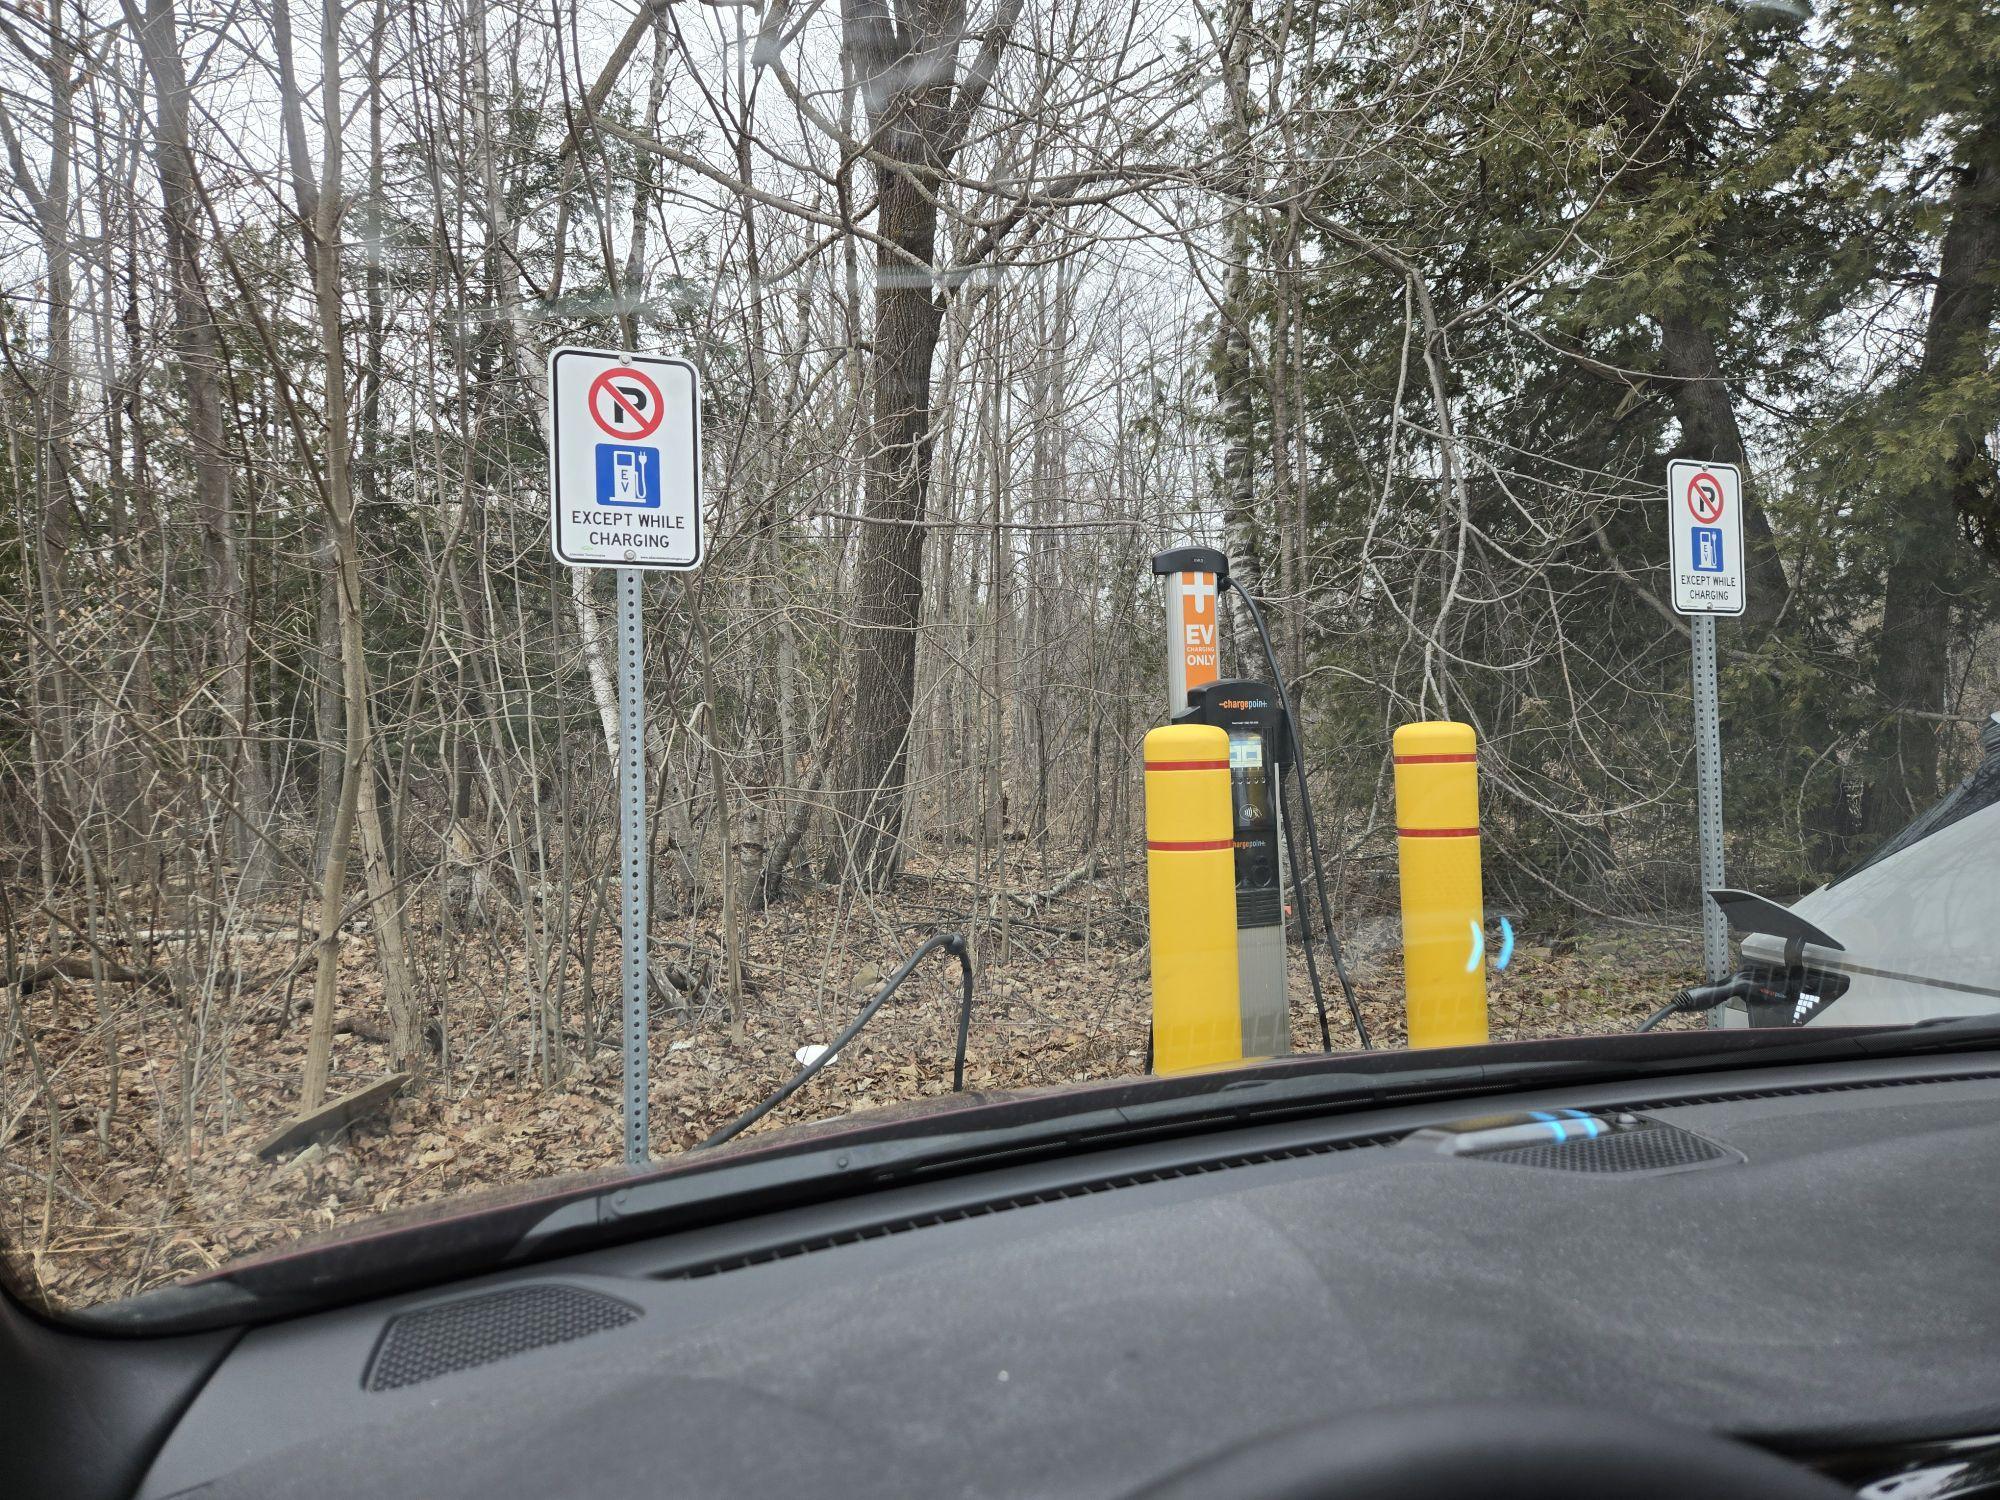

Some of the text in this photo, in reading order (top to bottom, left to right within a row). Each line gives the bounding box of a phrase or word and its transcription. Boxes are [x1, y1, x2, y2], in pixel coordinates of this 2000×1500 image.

[614, 386, 647, 424] P
[1699, 486, 1716, 512] P
[572, 511, 685, 529] EXCEPT WHILE
[589, 532, 670, 548] CHARGING
[1681, 575, 1736, 587] EXCEPT WHILE
[1690, 589, 1729, 600] CHARGING
[1186, 624, 1214, 645] EV
[1187, 654, 1215, 666] ONLY
